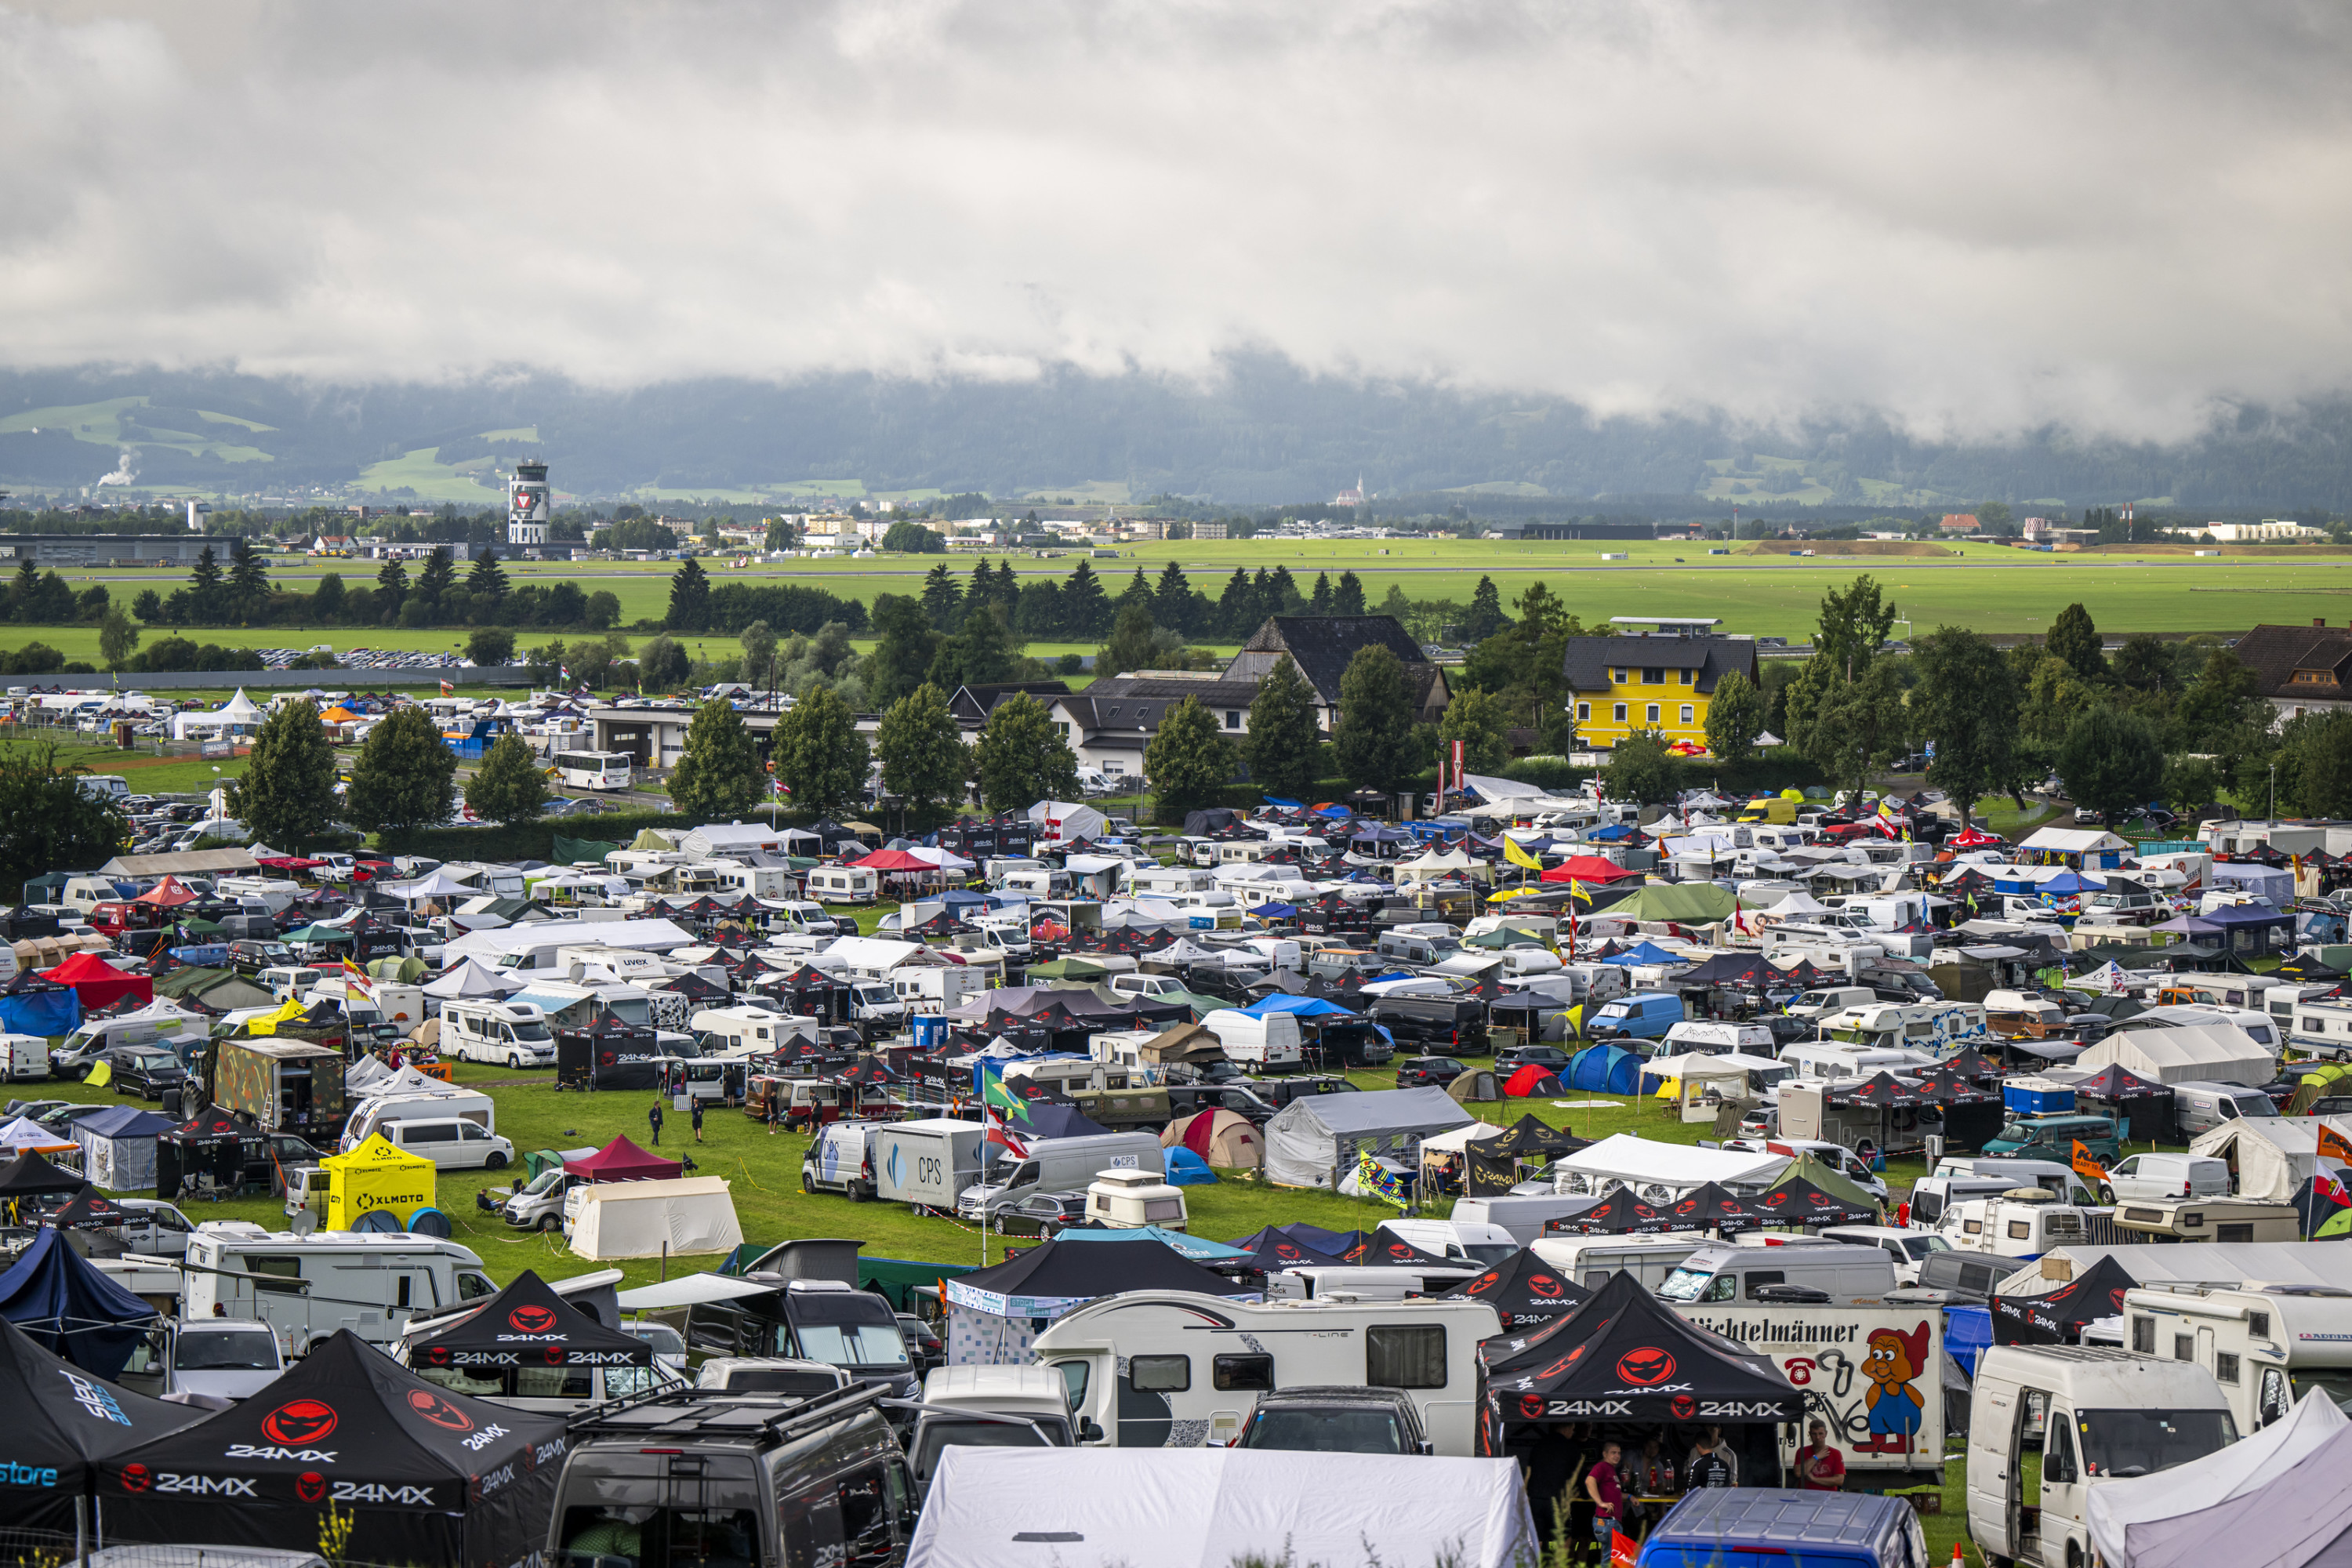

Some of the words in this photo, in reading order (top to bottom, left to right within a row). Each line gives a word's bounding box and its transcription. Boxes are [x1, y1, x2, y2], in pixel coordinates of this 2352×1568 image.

[1031, 907, 1048, 918] BLUMEN
[1048, 907, 1067, 920] PARADIES
[623, 958, 648, 967] uvex
[823, 1140, 840, 1161] CPS
[1120, 1156, 1136, 1167] CPS
[2075, 1160, 2090, 1168] READY
[918, 1156, 942, 1185] CPS
[376, 1194, 423, 1205] XLMOTO
[123, 1216, 151, 1225] 24MX
[1514, 1314, 1552, 1323] 24M
[2001, 1303, 2020, 1319] 24MX
[2034, 1315, 2056, 1330] 24MX
[452, 1352, 521, 1364] 24MX
[568, 1352, 635, 1364] 24MX
[59, 1370, 115, 1422] sled
[1548, 1400, 1633, 1415] 24MX
[1700, 1402, 1784, 1417] 24MX
[462, 1423, 510, 1450] 24MX
[225, 1444, 338, 1463] 24MX
[536, 1436, 567, 1464] 24MX
[155, 1473, 258, 1497] 24MX
[482, 1463, 515, 1494] 24MX
[330, 1482, 435, 1505] 24MX
